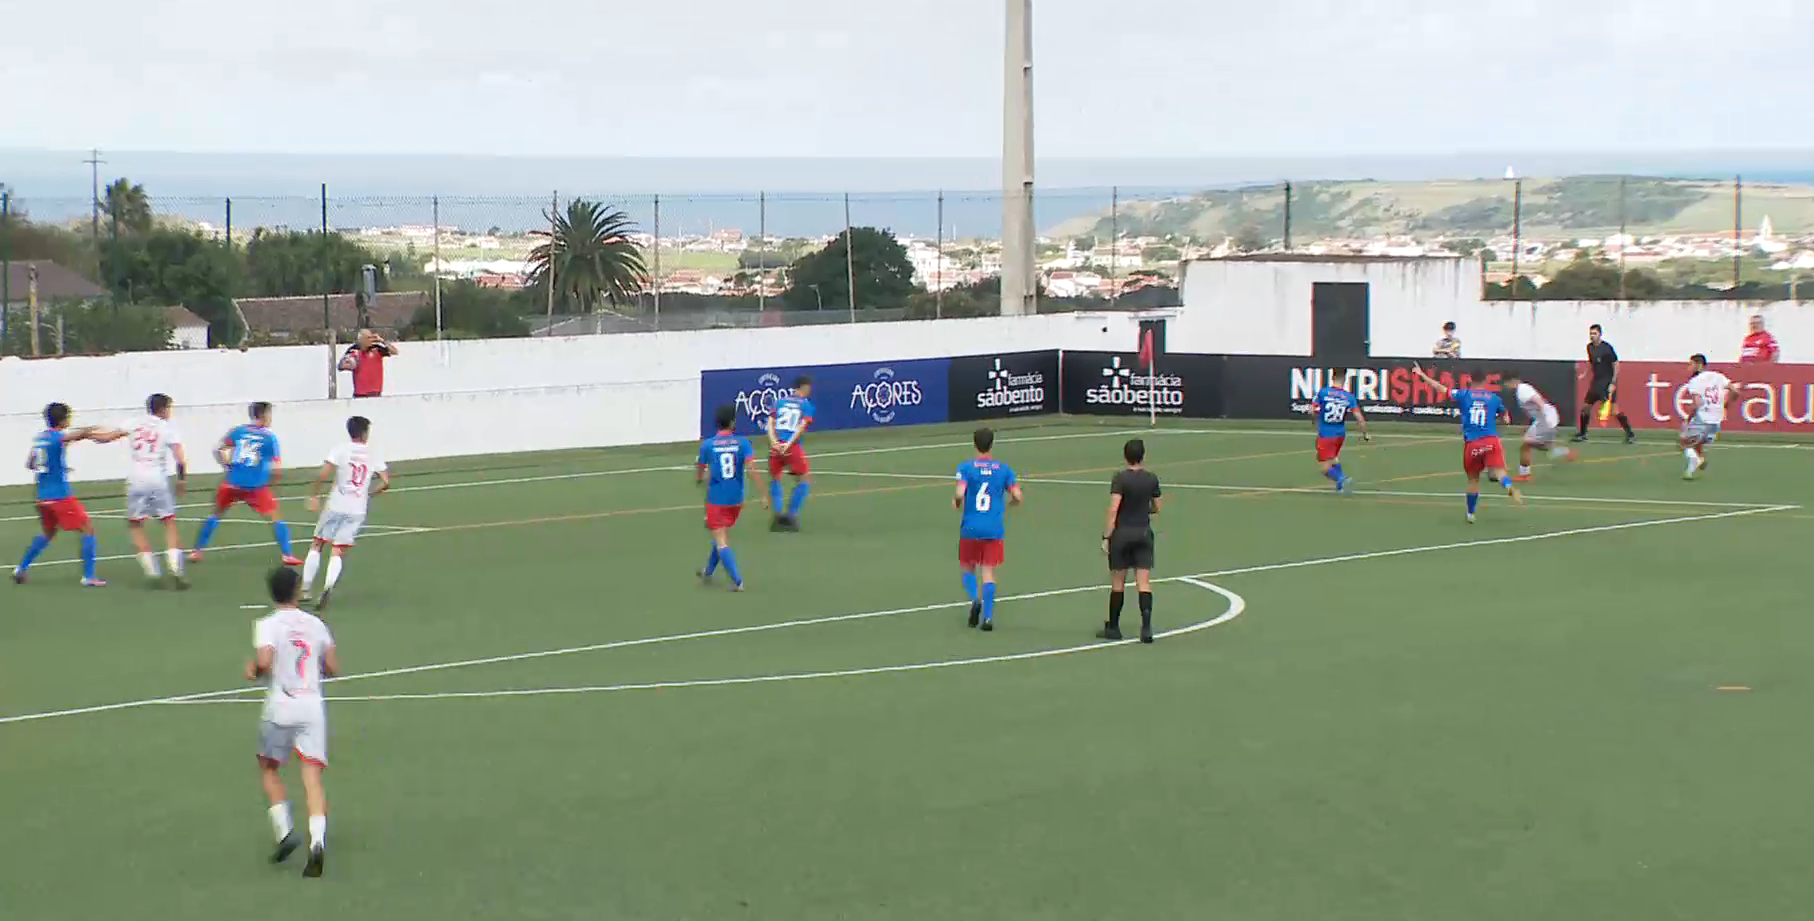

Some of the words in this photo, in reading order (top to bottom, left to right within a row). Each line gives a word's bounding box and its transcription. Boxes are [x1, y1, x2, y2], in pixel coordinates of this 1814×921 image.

[1008, 371, 1043, 386] farmácia
[1129, 372, 1182, 386] farmácia
[850, 380, 922, 414] AÇORES
[977, 385, 1044, 407] sãobento
[1086, 384, 1184, 405] sãobento
[1469, 406, 1486, 426] 10
[720, 453, 735, 478] 8
[976, 482, 990, 511] 6
[289, 639, 311, 684] 7
